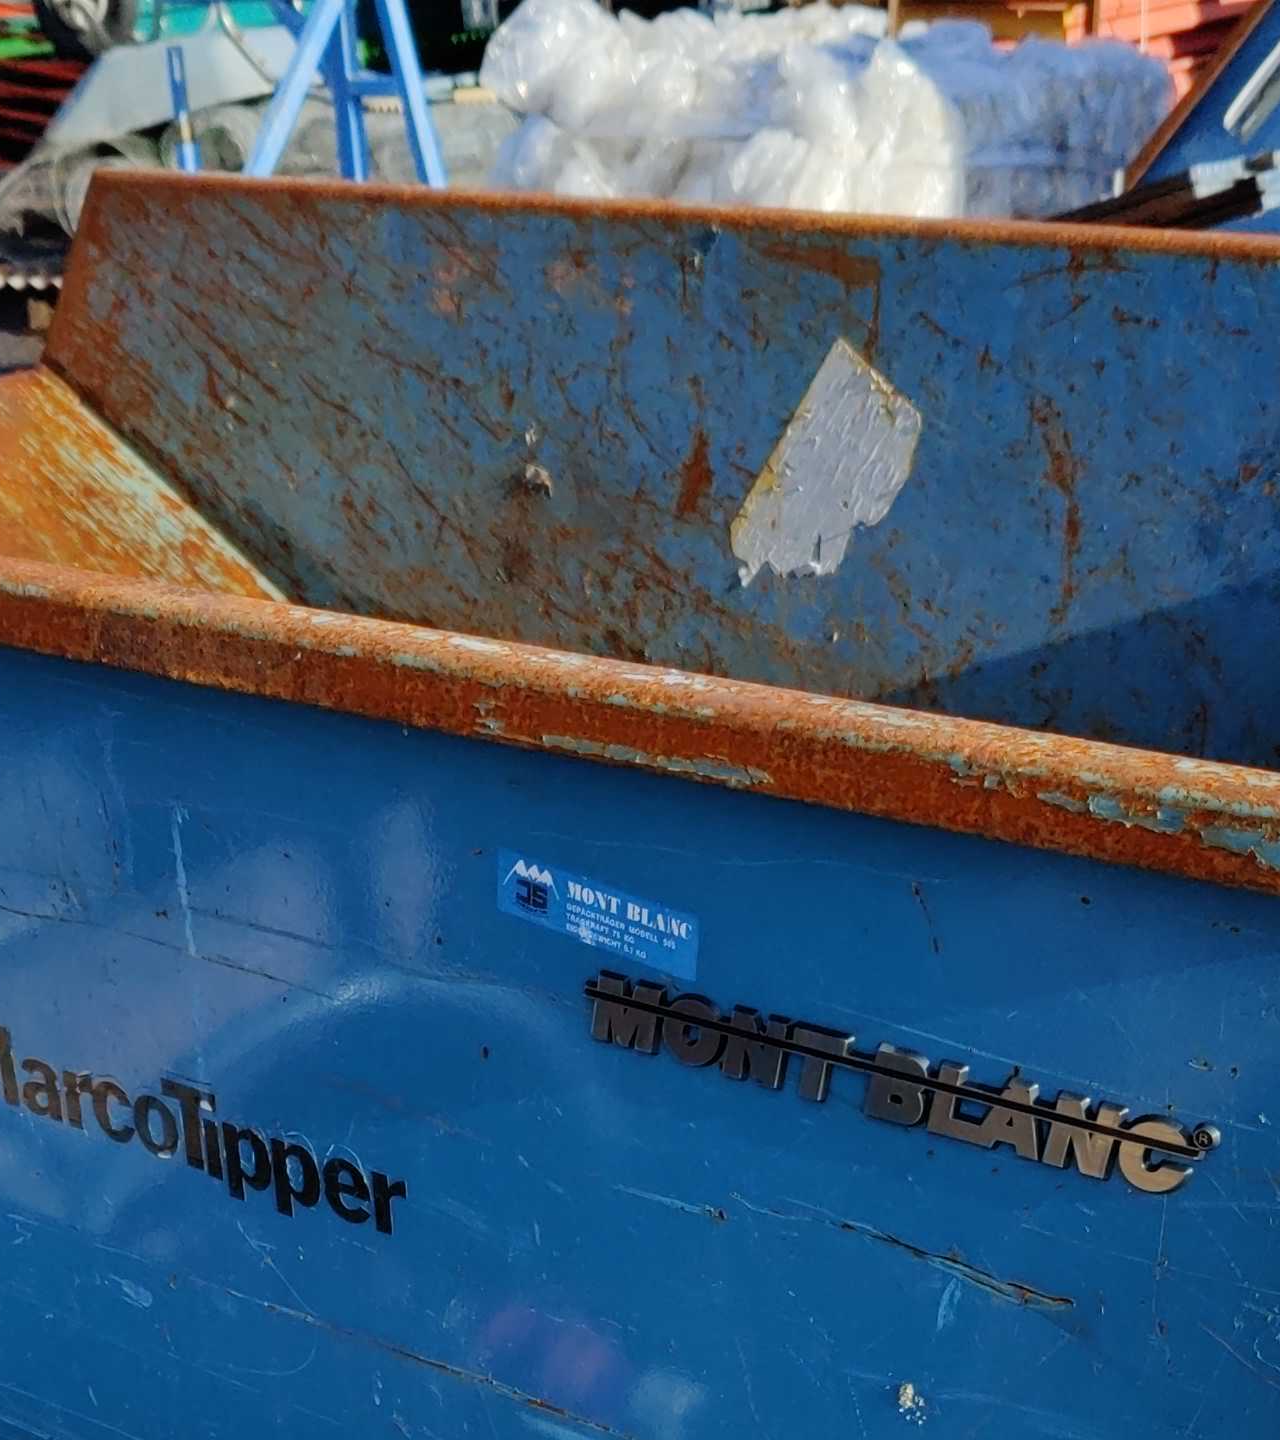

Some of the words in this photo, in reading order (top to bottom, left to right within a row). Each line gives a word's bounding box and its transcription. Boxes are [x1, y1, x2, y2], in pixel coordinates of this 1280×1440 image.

[567, 880, 621, 915] MONT
[626, 902, 692, 940] BLANC
[588, 970, 856, 1102] MONT
